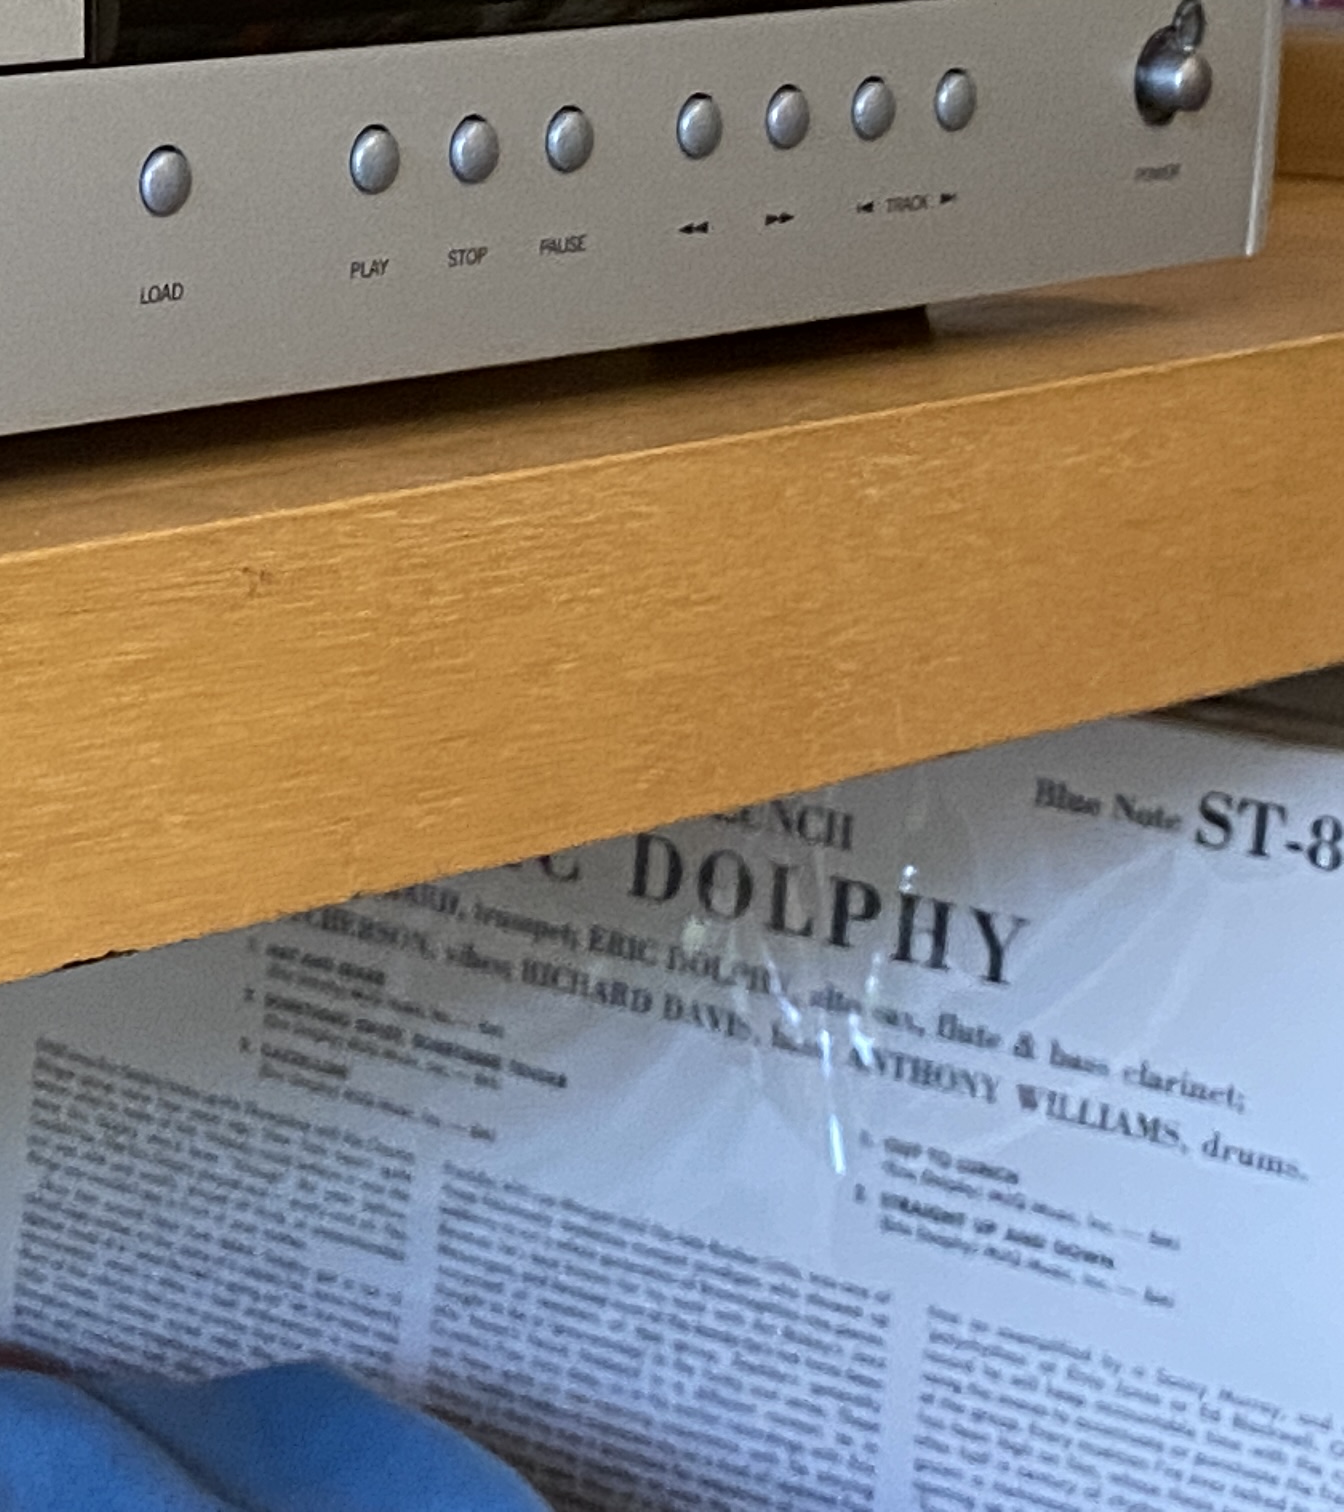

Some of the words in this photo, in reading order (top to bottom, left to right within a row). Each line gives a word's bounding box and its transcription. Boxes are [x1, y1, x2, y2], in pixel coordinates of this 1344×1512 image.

[885, 194, 929, 214] TRACK
[538, 233, 588, 255] PAUSE
[447, 246, 489, 268] STOP
[349, 258, 389, 280] PLAY
[139, 282, 185, 305] LOAD
[628, 830, 1031, 985] DOLPHY
